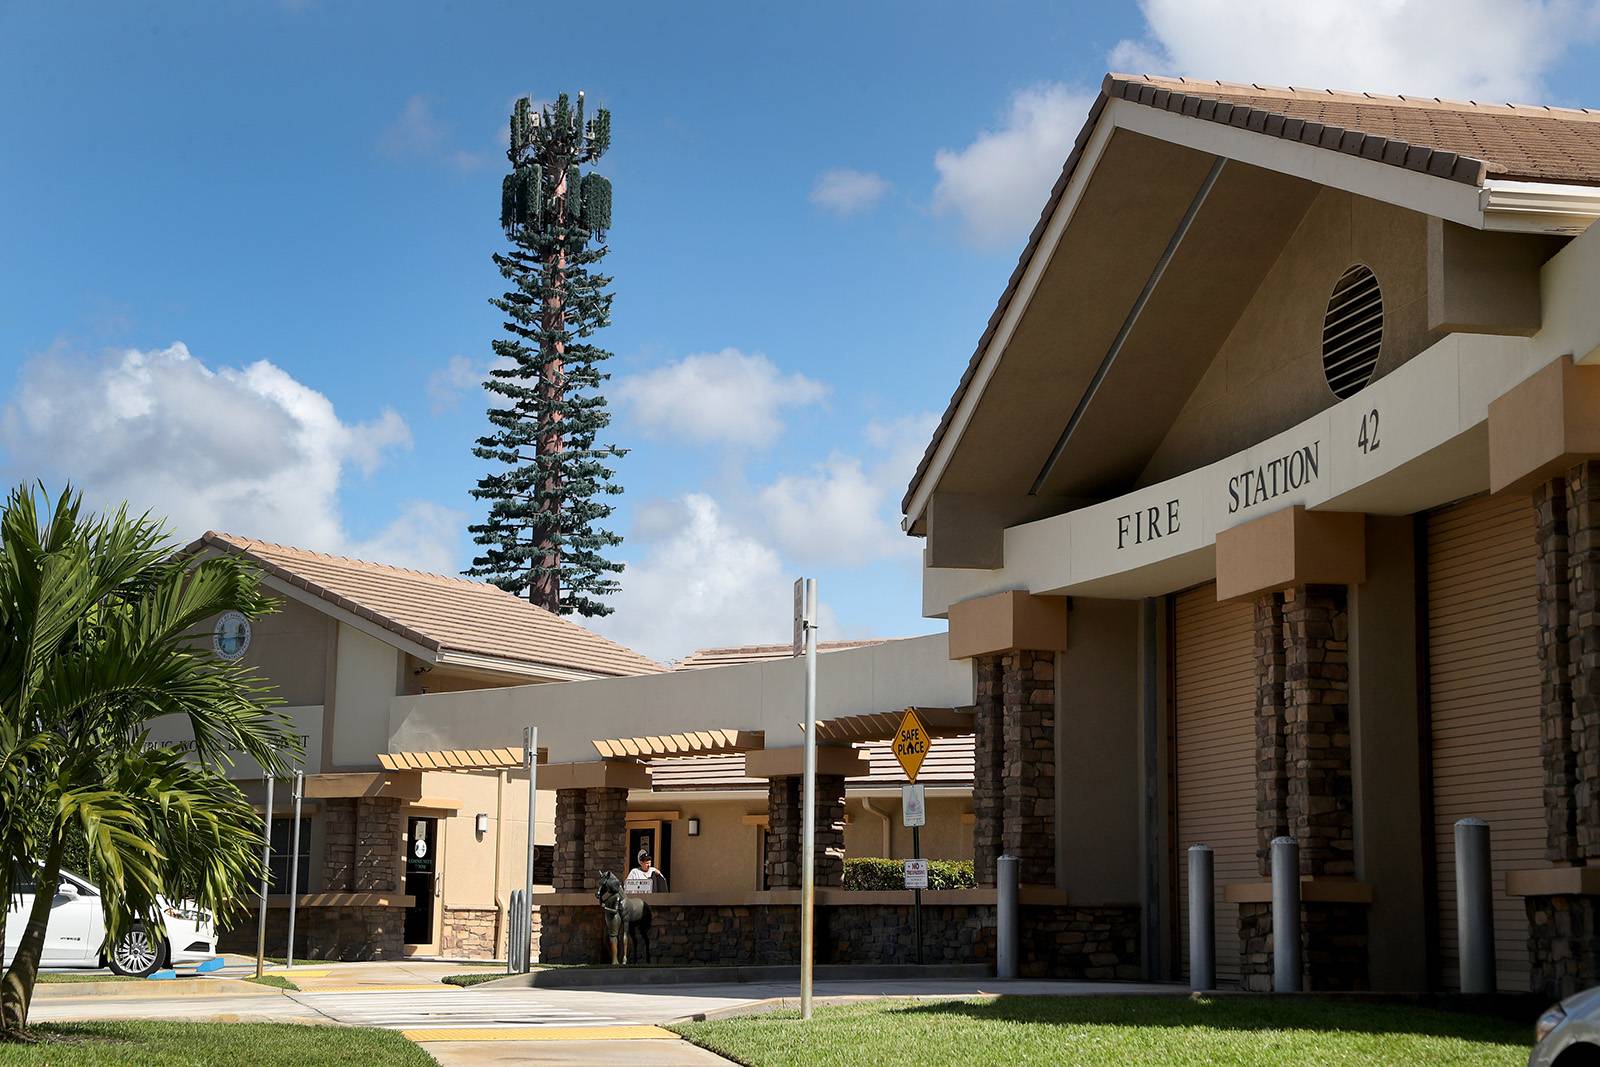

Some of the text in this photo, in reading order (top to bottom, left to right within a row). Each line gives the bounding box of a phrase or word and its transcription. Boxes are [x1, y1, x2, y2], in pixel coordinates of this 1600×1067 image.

[1117, 408, 1381, 549] FIRE STATION 42
[901, 728, 920, 742] SAFE
[897, 740, 925, 755] PLACE
[911, 862, 920, 870] NO
